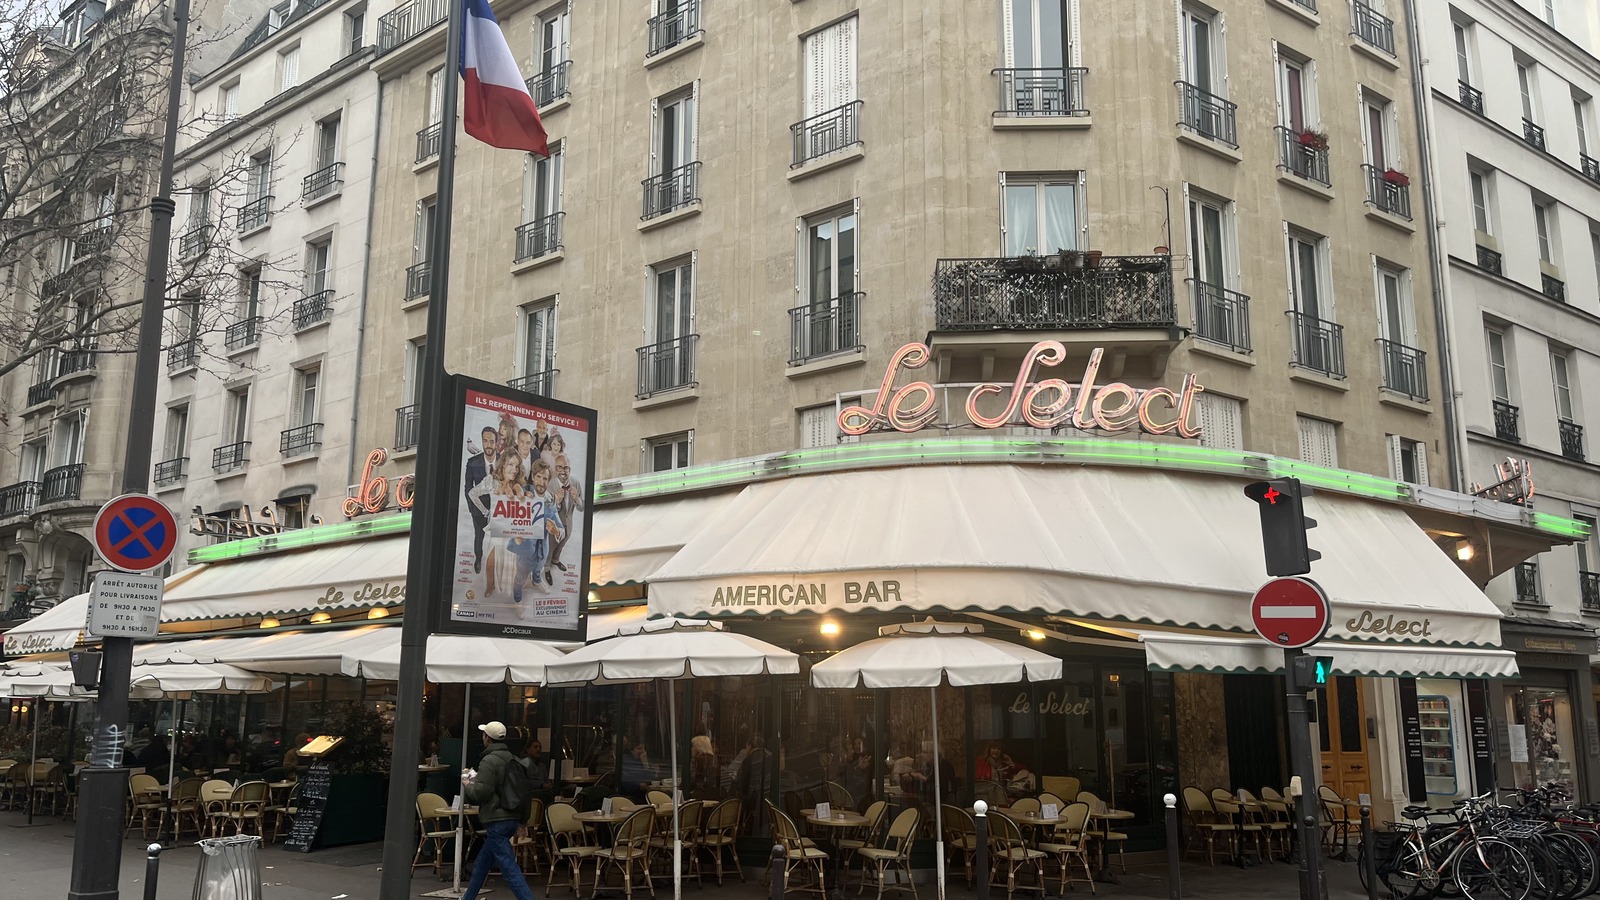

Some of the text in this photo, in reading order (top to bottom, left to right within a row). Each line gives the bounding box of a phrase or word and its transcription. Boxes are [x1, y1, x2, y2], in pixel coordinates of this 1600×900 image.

[837, 340, 1204, 439] Le Select
[476, 397, 487, 405] ILS
[489, 400, 535, 417] REPRENNENT
[536, 411, 547, 419] DU
[548, 414, 575, 426] SERVICE
[341, 447, 391, 518] Le
[492, 500, 545, 526] Alibi 2
[120, 593, 158, 601] LIVRAISONS
[127, 582, 158, 590] AUTORISÉ
[317, 586, 345, 606] Le
[711, 580, 902, 607] AMERICAN BAR
[502, 626, 532, 635] JCDecaux
[1345, 610, 1431, 637] Select
[5, 634, 55, 651] Le Select
[1008, 691, 1090, 716] Le Select
